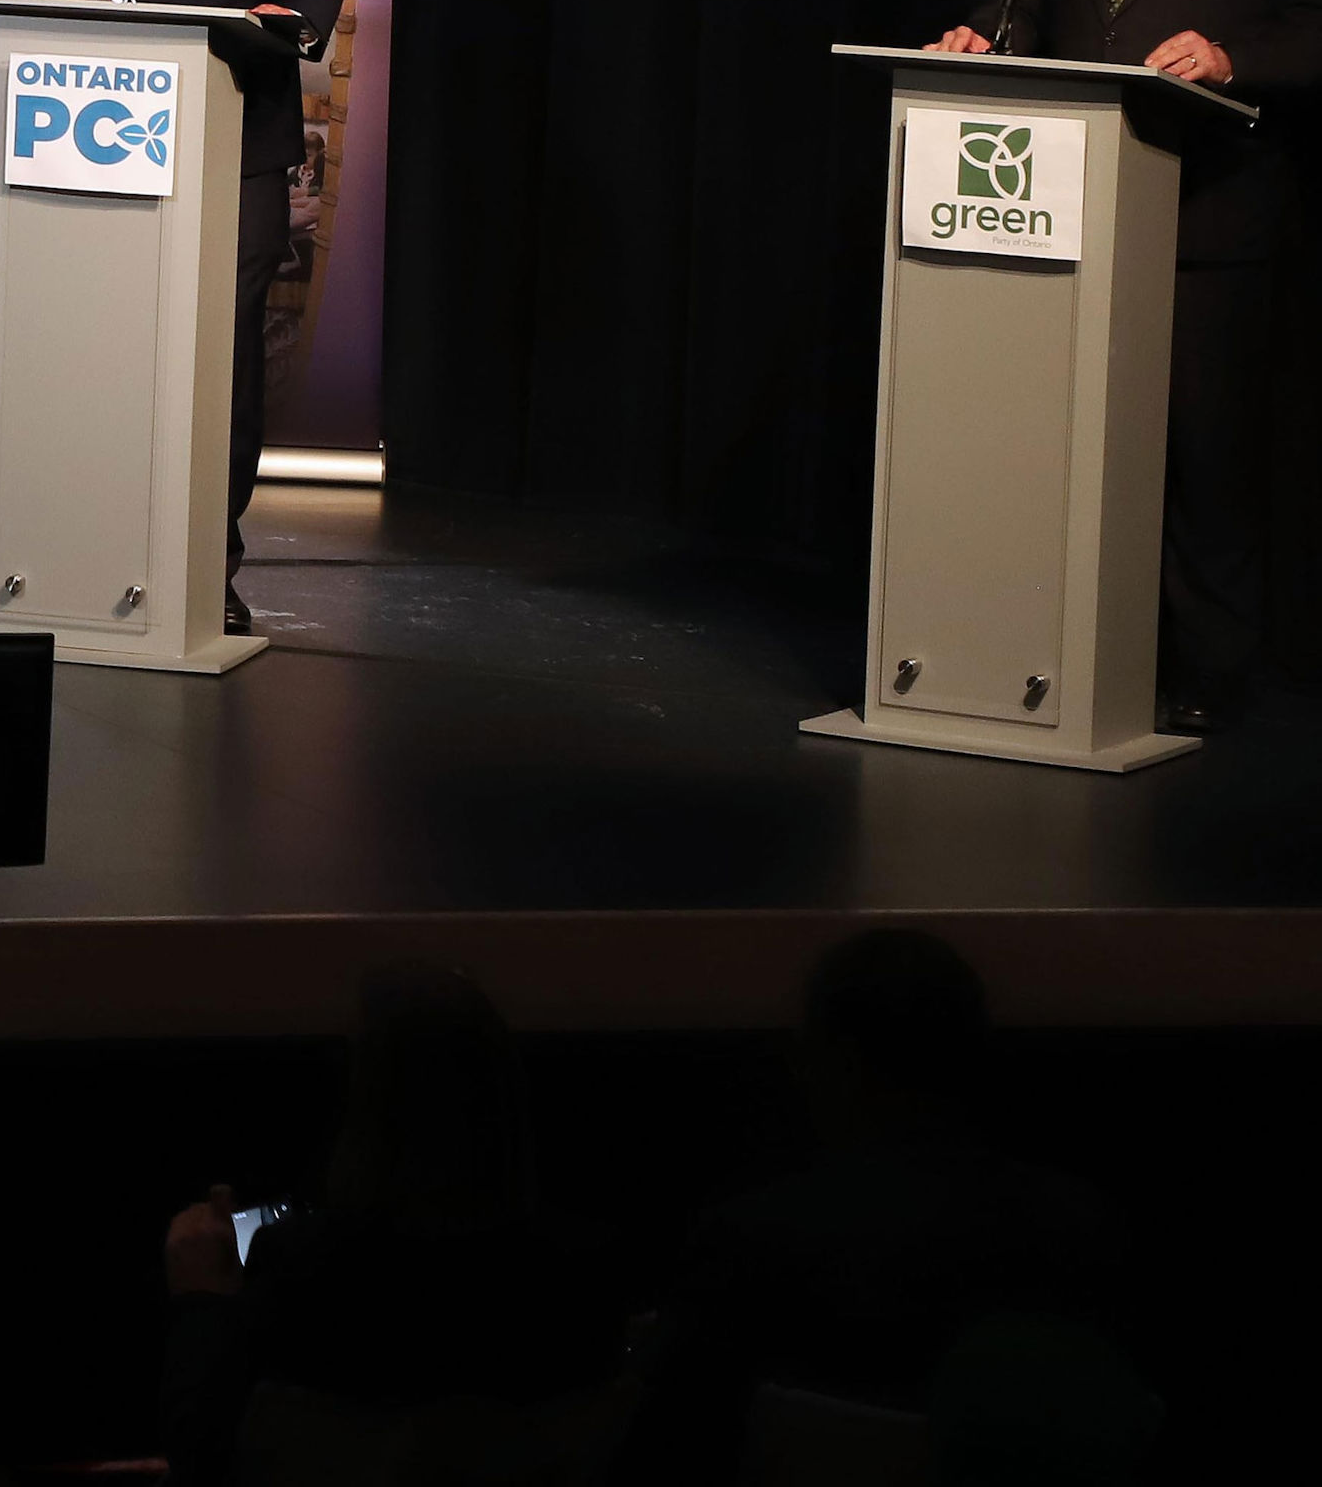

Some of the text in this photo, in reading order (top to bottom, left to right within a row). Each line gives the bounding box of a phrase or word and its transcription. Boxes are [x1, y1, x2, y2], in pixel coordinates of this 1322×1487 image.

[16, 61, 172, 94] ONTARIO
[13, 94, 134, 166] PC
[930, 202, 1052, 239] green
